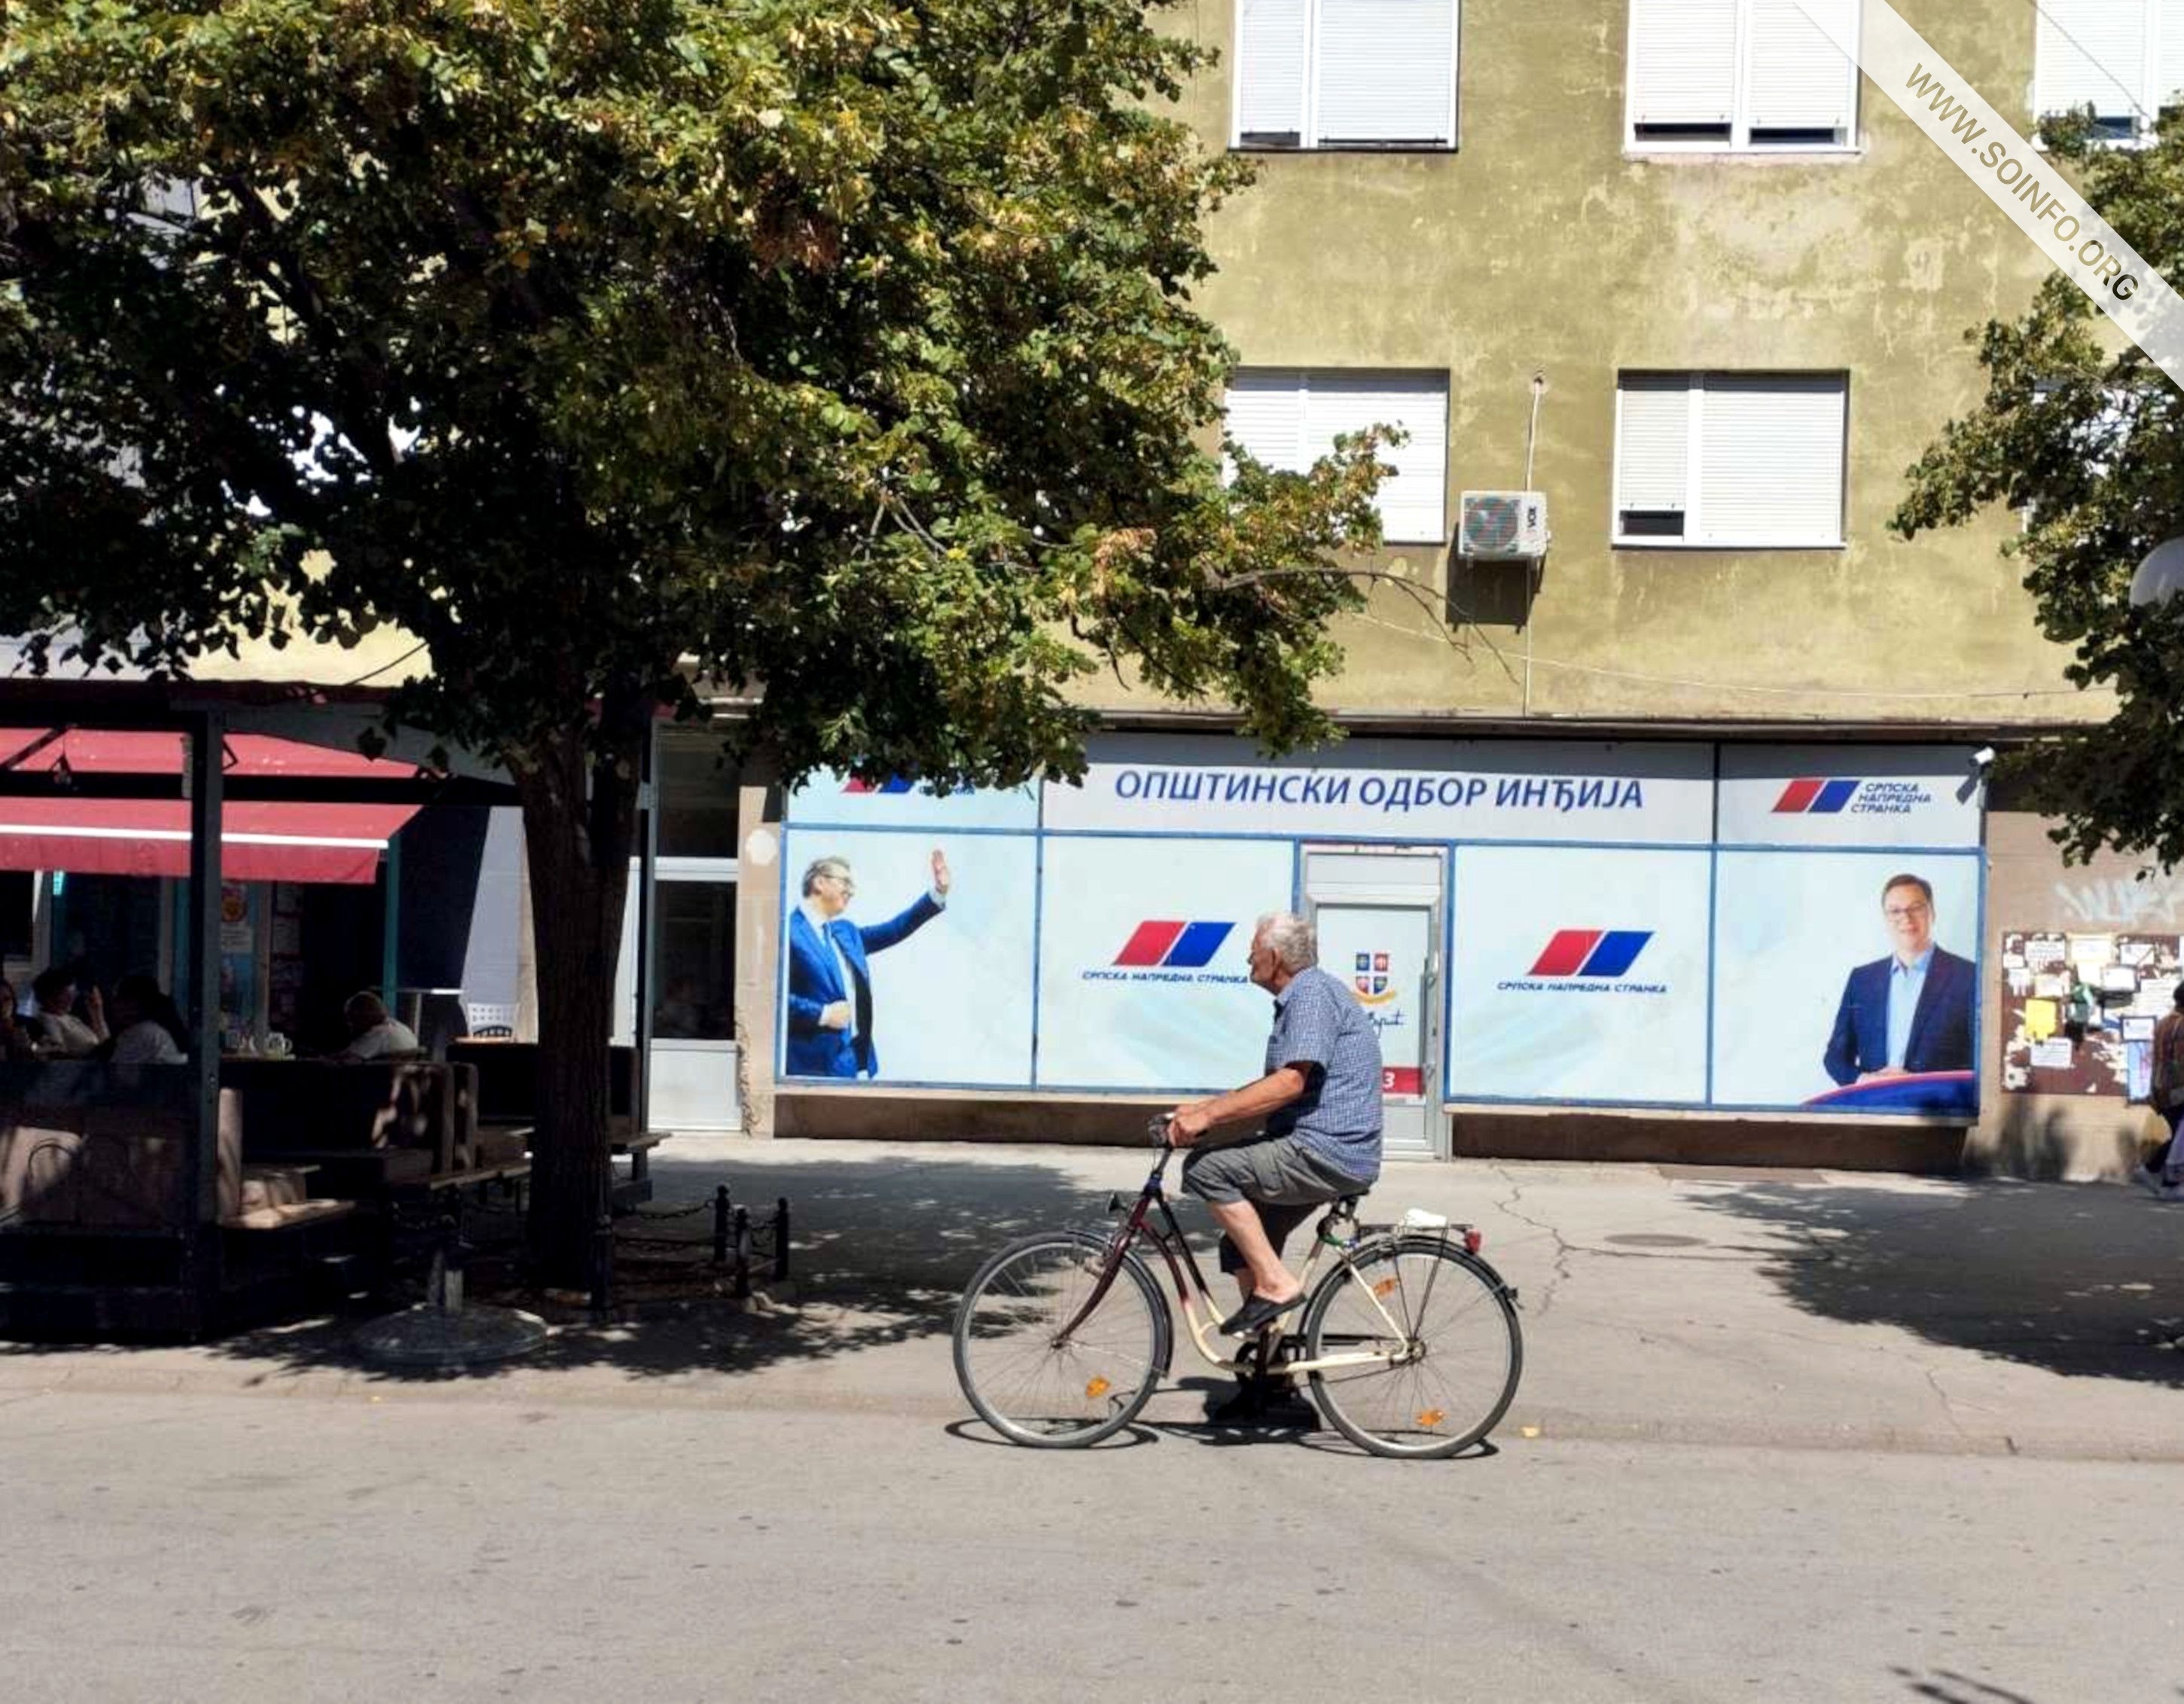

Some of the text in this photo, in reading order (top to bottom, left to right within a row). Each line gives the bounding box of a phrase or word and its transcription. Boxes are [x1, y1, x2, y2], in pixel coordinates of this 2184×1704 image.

[1115, 770, 1643, 813] ОПШТИНСКИ ОДБОР ИНЂИЈА
[1865, 783, 1919, 792] СРПСКА
[1858, 793, 1931, 803] НАПРЕДНА
[1850, 804, 1911, 814] СТРАНКА
[1082, 970, 1249, 984] СРПСКА НАПРЕДНА СТРАНКА
[1497, 982, 1667, 994] СРПСКА НАПРЕДНА СТРАНКА
